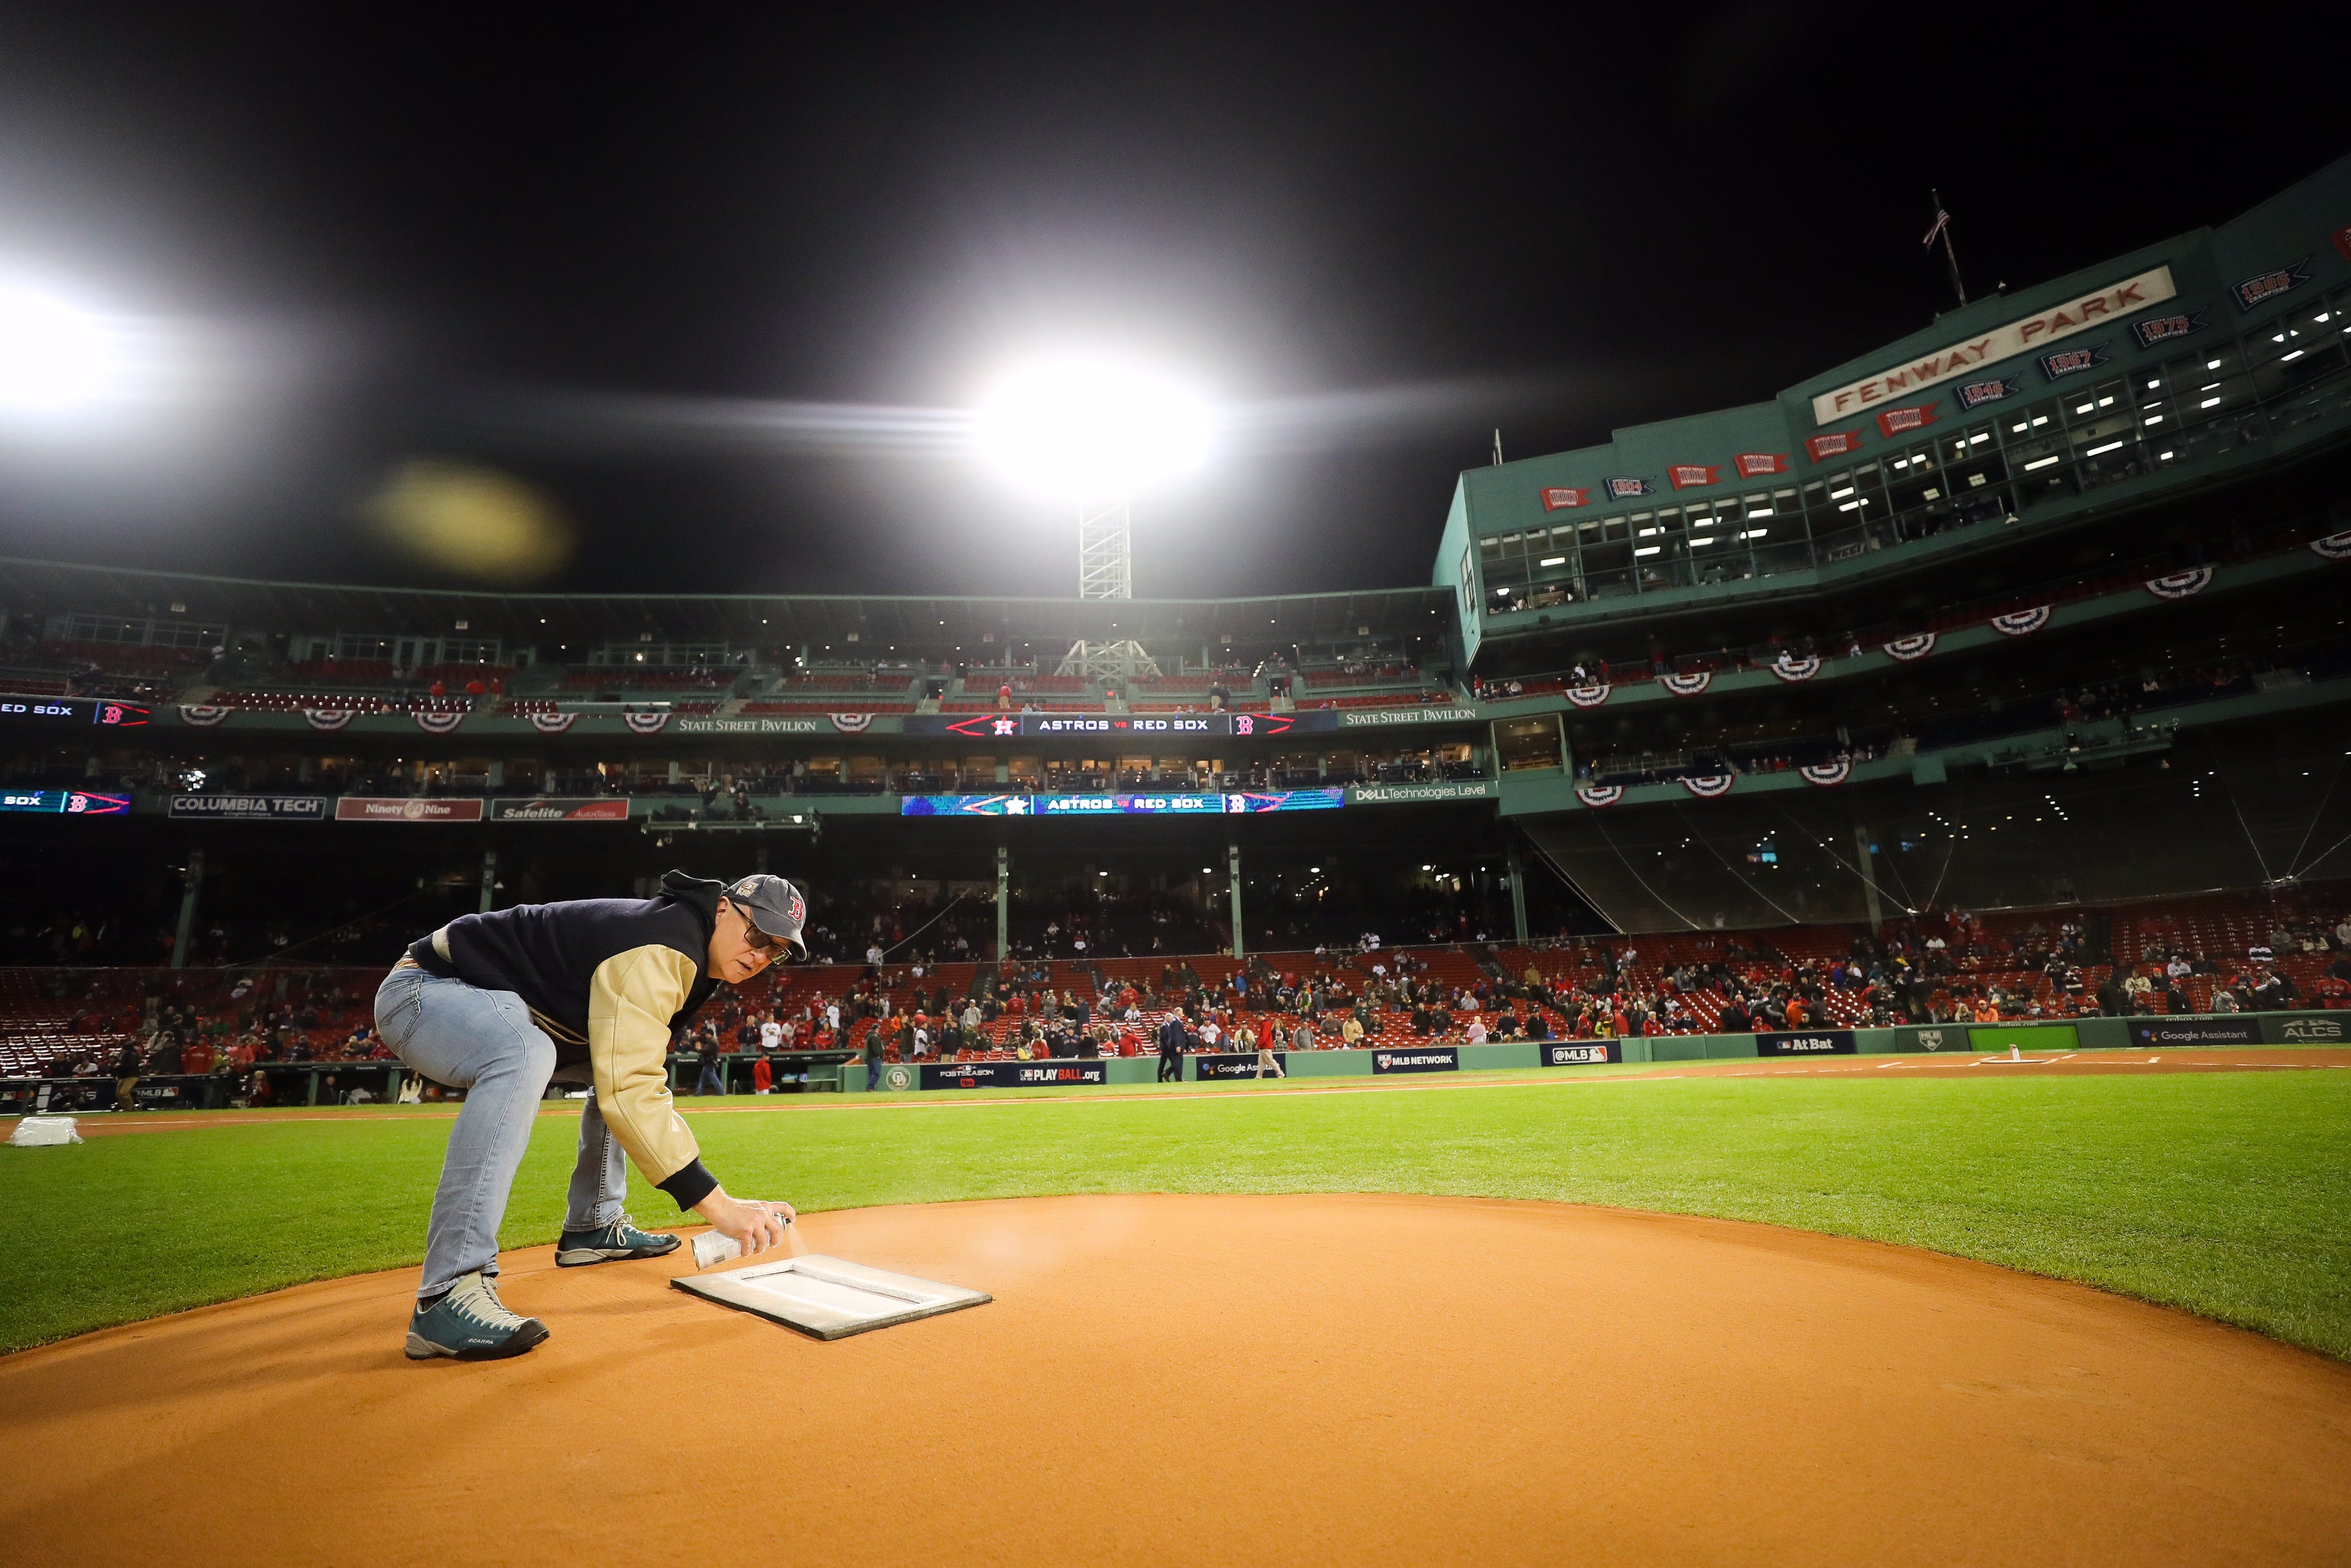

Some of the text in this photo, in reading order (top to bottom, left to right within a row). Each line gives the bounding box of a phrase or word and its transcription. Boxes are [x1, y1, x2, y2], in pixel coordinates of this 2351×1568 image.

[2242, 273, 2290, 300] 1986
[2143, 317, 2189, 338] 1975
[1834, 282, 2145, 412] FENWAY PARK
[2050, 352, 2091, 371] 1967
[1965, 383, 2004, 401] 1946
[1817, 438, 1847, 451] 1916
[1745, 459, 1775, 468] 1915
[1678, 471, 1707, 480] 1912
[1612, 482, 1642, 492] 1904
[1550, 493, 1578, 502] 1903
[33, 705, 73, 716] SOX
[102, 706, 123, 724] B
[1347, 709, 1476, 724] STATE STREET PAVILION
[679, 719, 816, 731] STATE STREET PAVILION
[1039, 720, 1110, 731] ASTROS
[1133, 720, 1167, 730] RED
[1173, 720, 1208, 730] SOX
[1236, 715, 1254, 735] B
[1356, 784, 1486, 801] DELL Technologies Level
[3, 796, 41, 805] SOX
[68, 795, 87, 812] B
[173, 798, 317, 812] COLUMBIA TECH
[1048, 799, 1113, 810] ASTROS
[1134, 798, 1166, 809] RED
[1171, 798, 1204, 808] SOX
[1228, 794, 1246, 813] B
[366, 804, 402, 815] Ninety
[424, 805, 451, 814] Nine
[503, 808, 616, 818] Safelite AutoGlass
[788, 896, 804, 921] B
[2162, 1031, 2198, 1041] Google
[2284, 1027, 2342, 1038] ALCS
[1793, 1038, 1833, 1050] At Bat
[1392, 1055, 1453, 1065] MLB NETWORK
[1555, 1050, 1588, 1061] @MLB
[940, 1069, 994, 1077] POSTSEASON
[1217, 1064, 1273, 1074] Google Asssta
